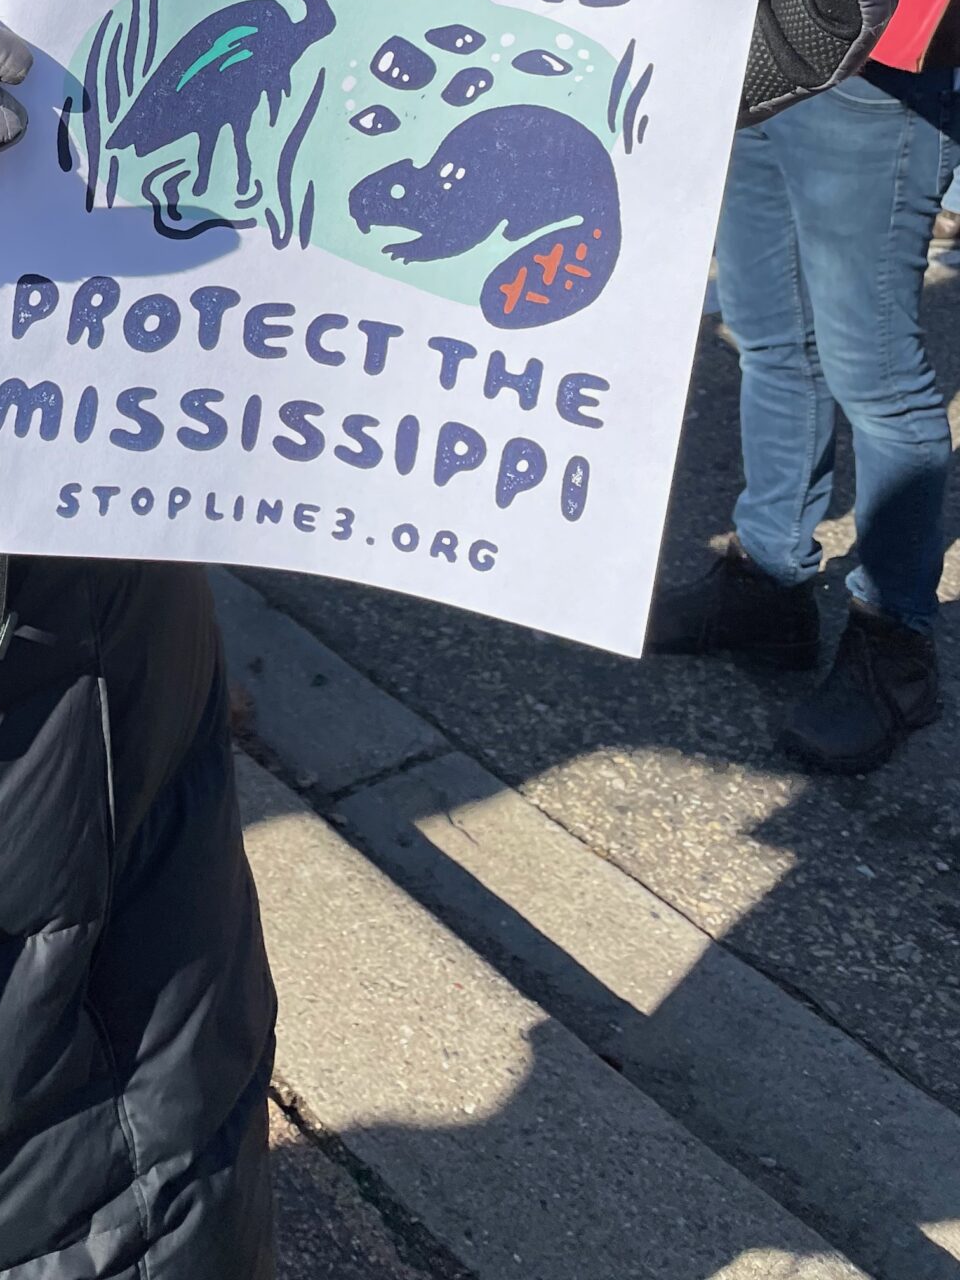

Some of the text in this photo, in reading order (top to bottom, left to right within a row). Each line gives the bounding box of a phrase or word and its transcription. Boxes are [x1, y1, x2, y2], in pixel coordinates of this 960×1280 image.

[10, 273, 610, 429] PROTECT THE
[55, 482, 499, 572] STOPLINE3.ORG
